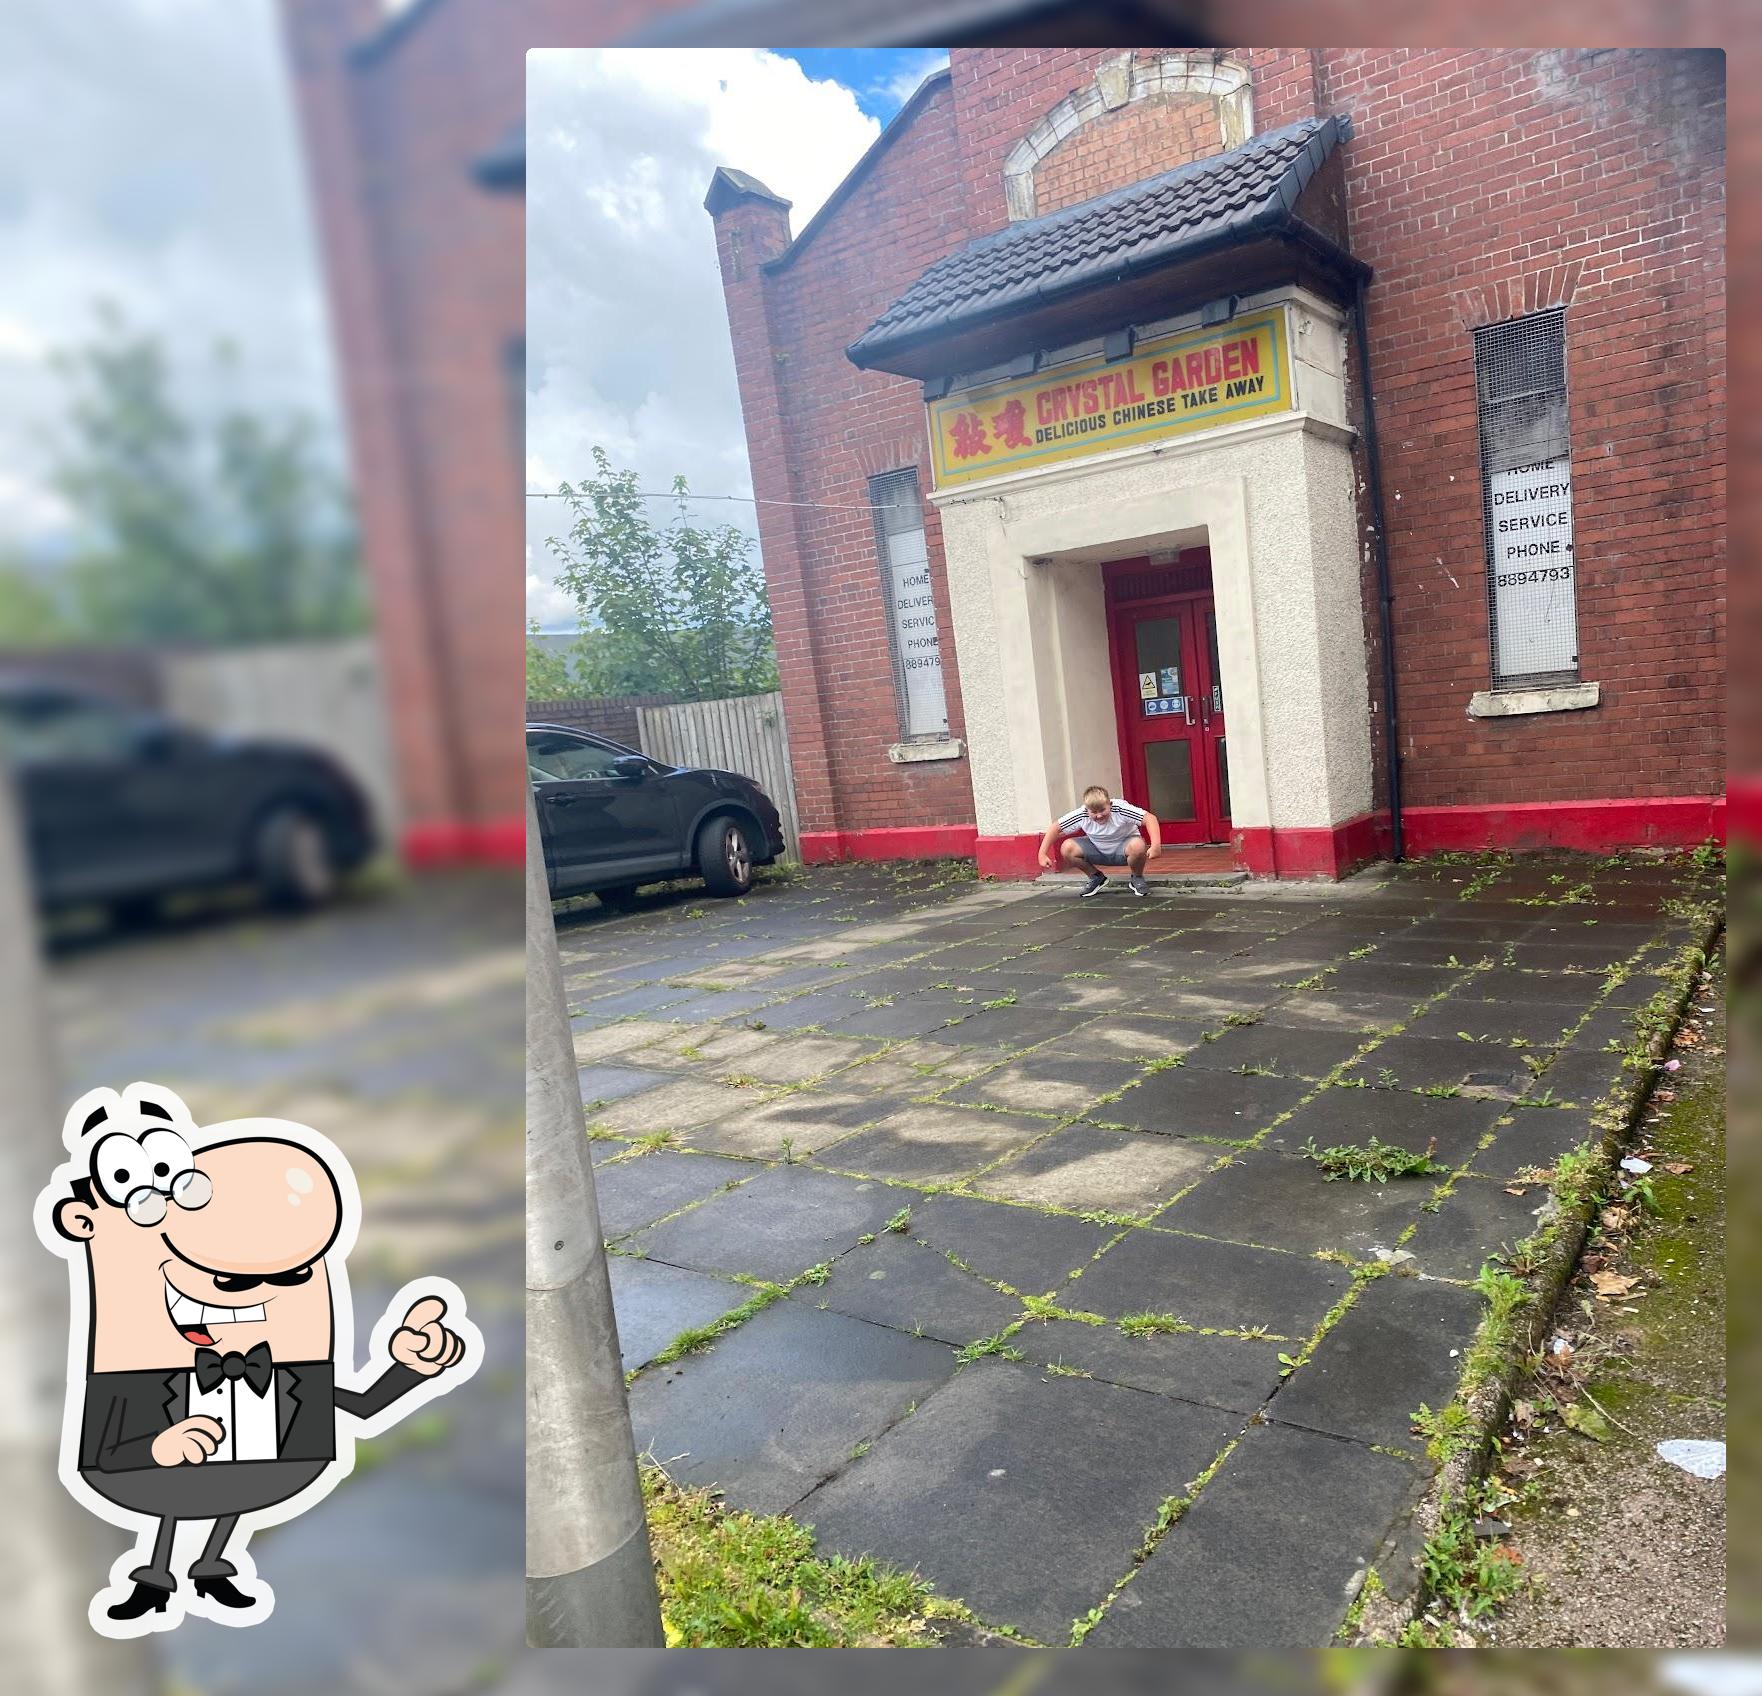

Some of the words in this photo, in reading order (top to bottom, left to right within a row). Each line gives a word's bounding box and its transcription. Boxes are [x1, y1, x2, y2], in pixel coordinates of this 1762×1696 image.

[1036, 368, 1145, 426] CRYSTAL
[1151, 337, 1260, 397] GARDEN
[1035, 414, 1106, 444] DELICIOUS
[1113, 397, 1176, 425] CHINESE
[1181, 386, 1218, 409] TAKE
[1226, 376, 1265, 400] AWAY
[1494, 482, 1570, 506] DELIVERY
[1498, 511, 1568, 533] SERVICE
[1507, 540, 1560, 559] PHONE
[903, 574, 929, 588] HOME
[1497, 566, 1570, 587] 8894793
[907, 637, 939, 649] PHONE
